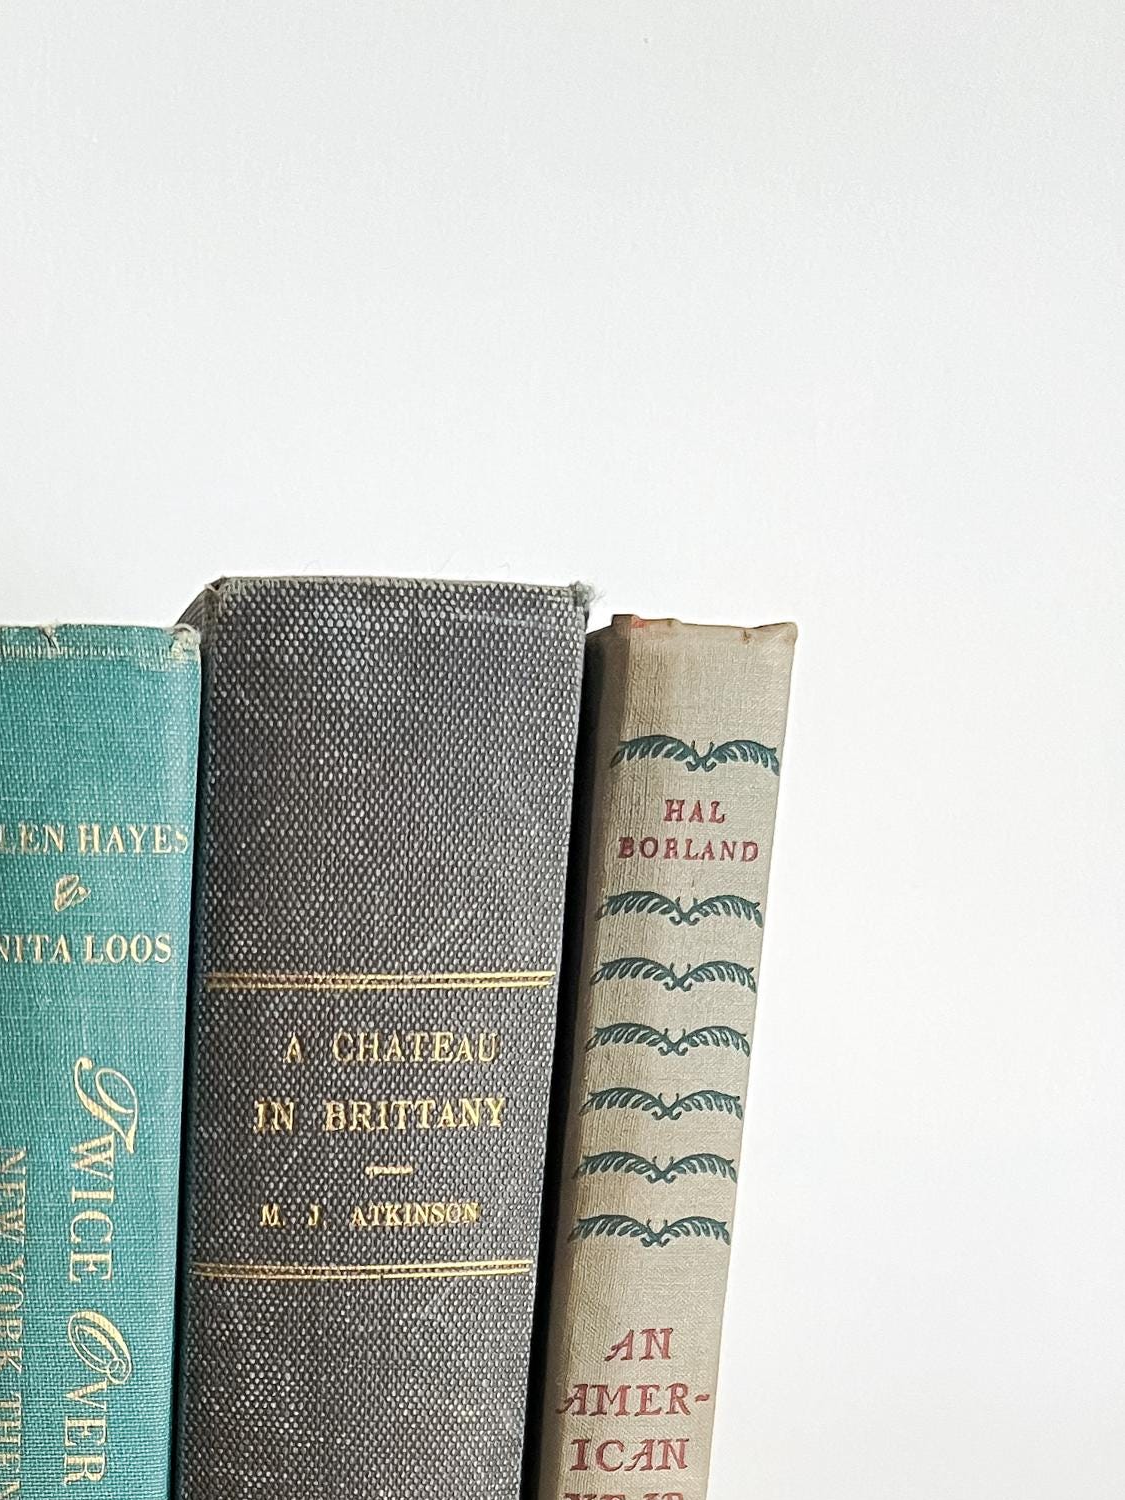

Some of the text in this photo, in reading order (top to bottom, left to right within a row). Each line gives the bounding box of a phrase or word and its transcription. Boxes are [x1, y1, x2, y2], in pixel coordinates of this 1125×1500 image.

[663, 799, 727, 824] HAL
[77, 823, 189, 855] HAYES
[617, 835, 760, 862] BORLAND
[83, 932, 173, 964] LOOS
[283, 1030, 502, 1063] A CHATEAU
[253, 1097, 507, 1134] IN BRITTANY
[69, 1056, 138, 1283] TWICE
[350, 1201, 482, 1230] ATKINSON
[604, 1327, 673, 1362] AN
[64, 1310, 132, 1485] OVER
[555, 1382, 711, 1417] AMER-
[570, 1438, 690, 1472] ICAN
